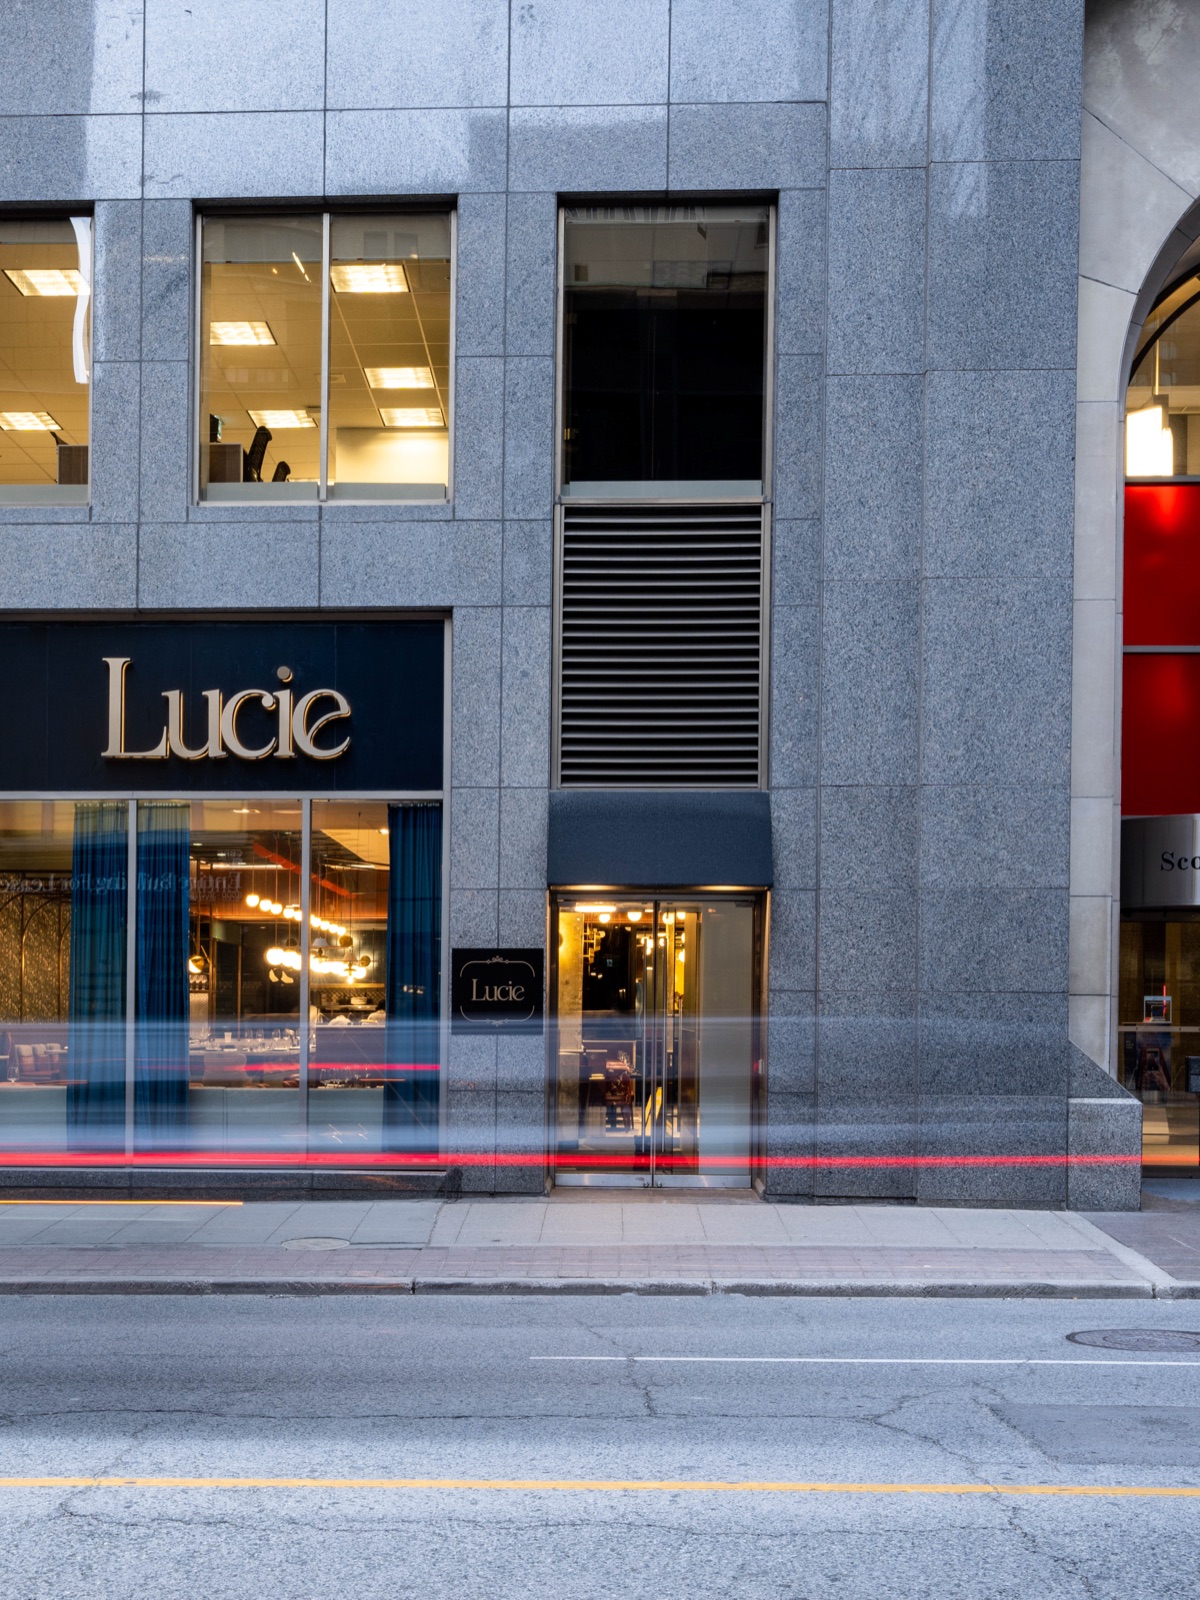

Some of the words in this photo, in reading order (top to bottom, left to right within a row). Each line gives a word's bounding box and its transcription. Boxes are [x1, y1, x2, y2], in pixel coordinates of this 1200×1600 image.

[101, 656, 351, 761] Lucie
[1160, 851, 1200, 872] Sco
[471, 978, 525, 1001] Lucie
